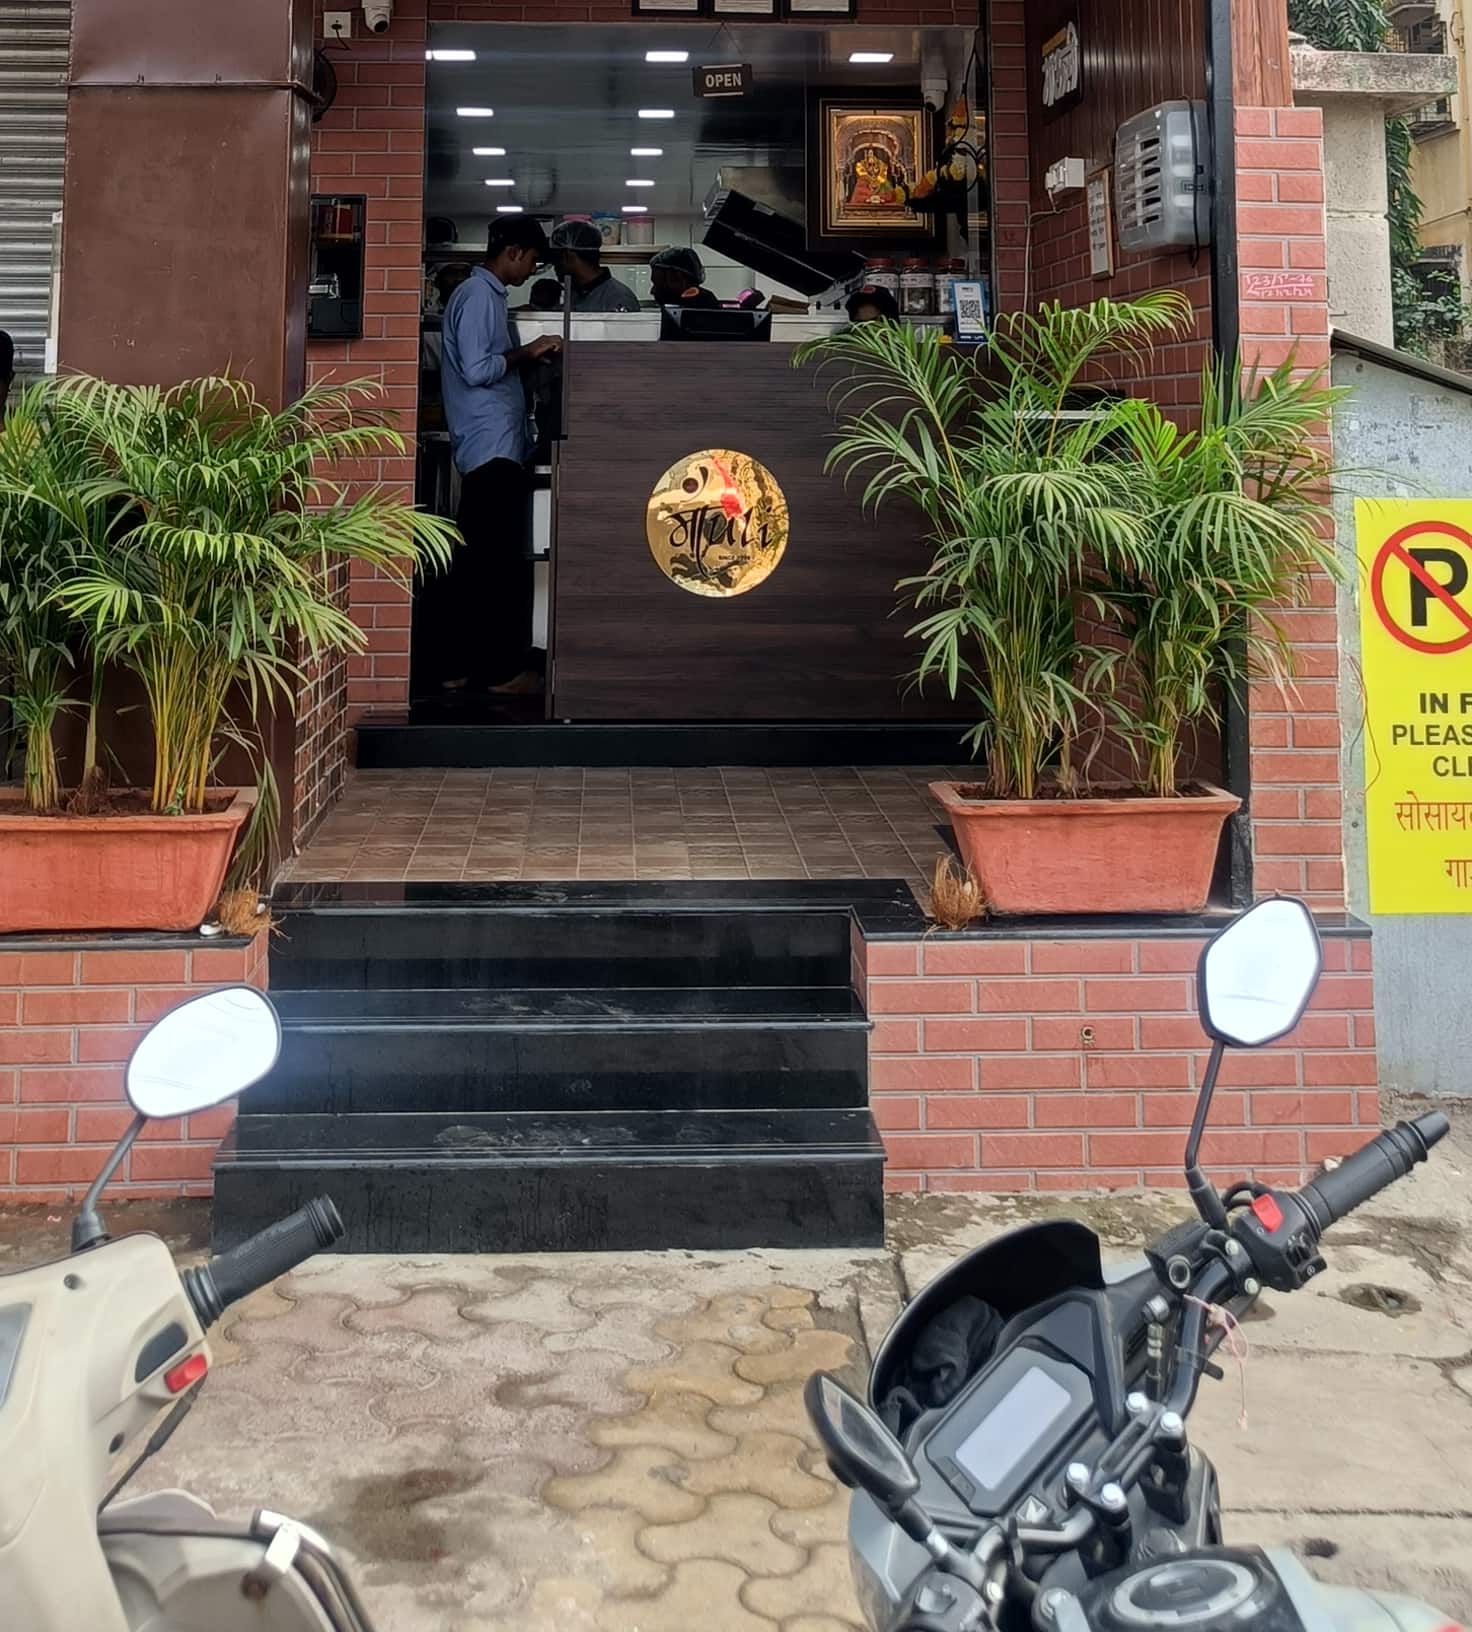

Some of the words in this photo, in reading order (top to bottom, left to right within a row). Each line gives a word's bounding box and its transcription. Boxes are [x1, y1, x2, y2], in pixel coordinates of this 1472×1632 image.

[705, 72, 742, 88] OPEN
[1419, 692, 1449, 714] IN
[1432, 755, 1472, 777] CL
[1394, 790, 1472, 831] सोसाय
